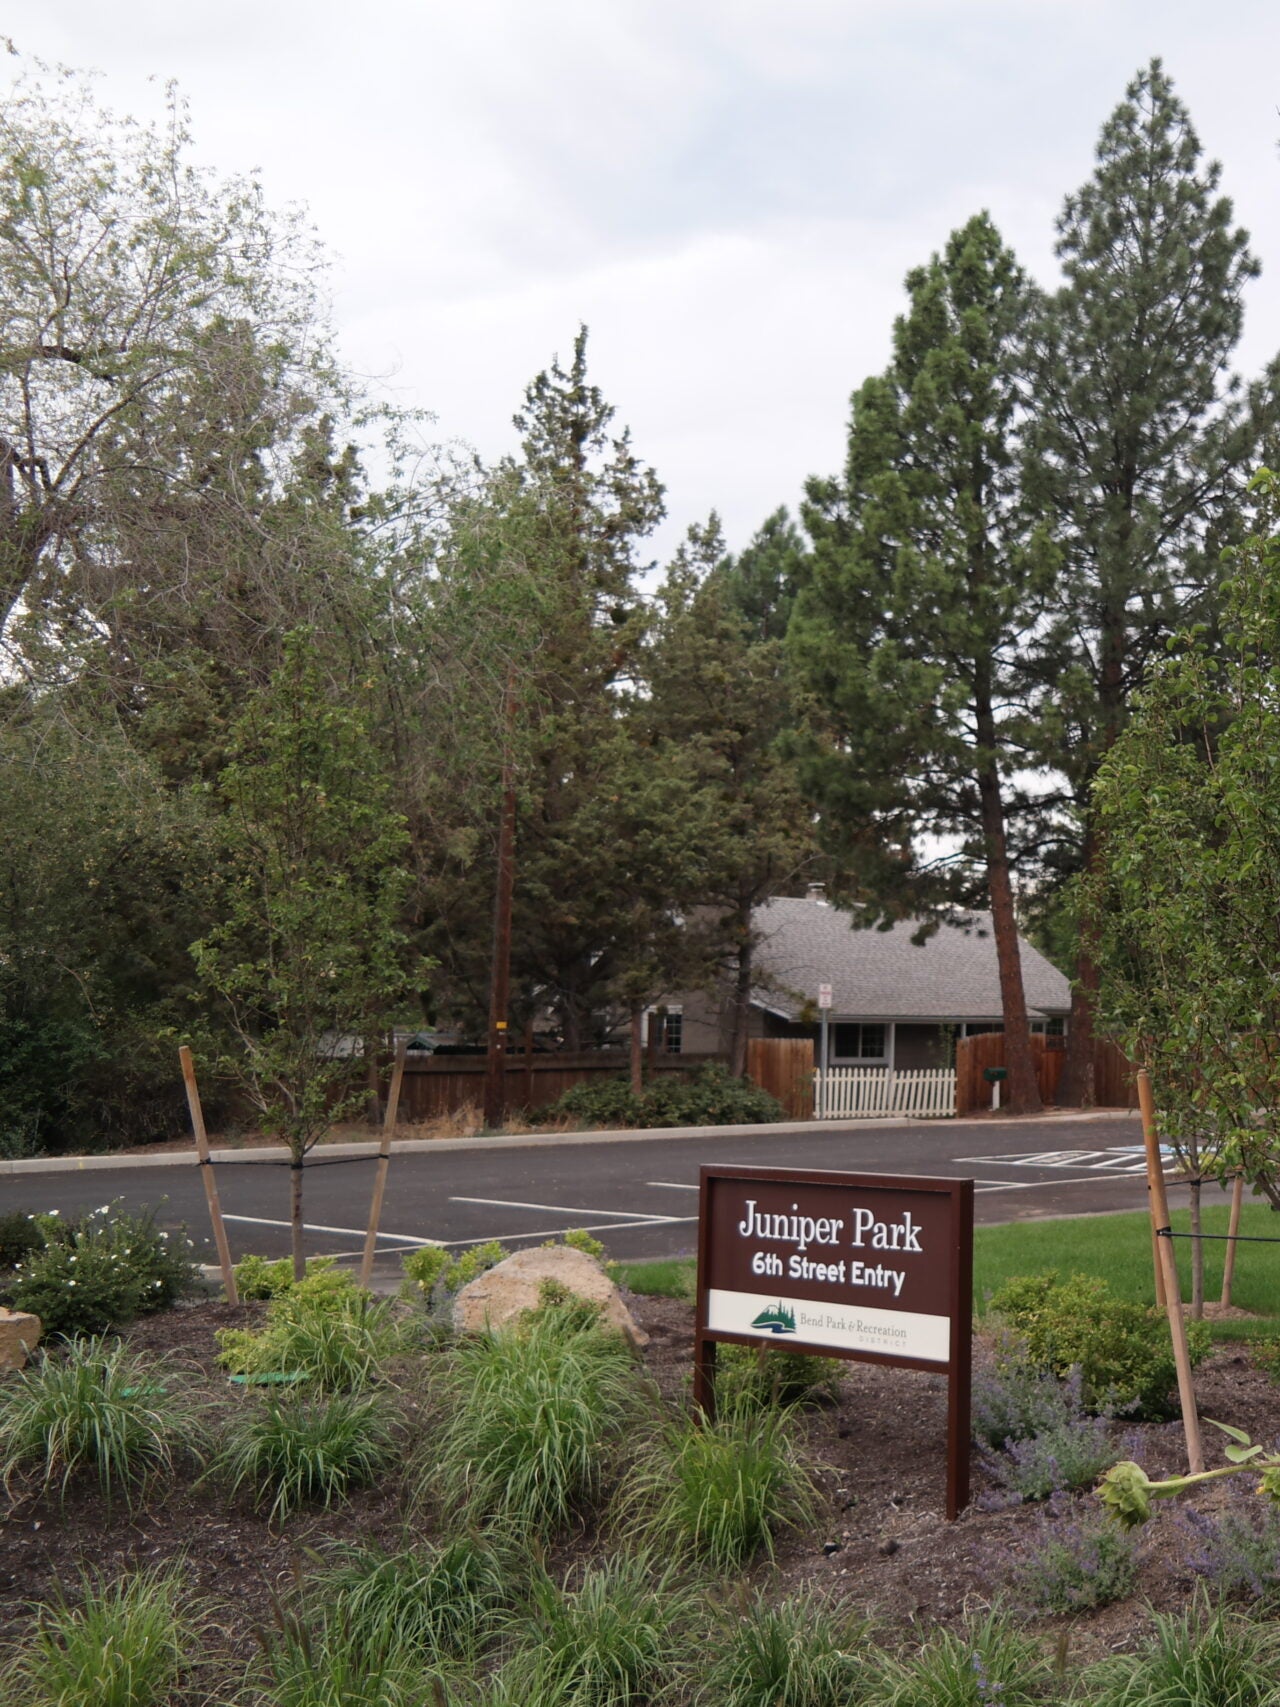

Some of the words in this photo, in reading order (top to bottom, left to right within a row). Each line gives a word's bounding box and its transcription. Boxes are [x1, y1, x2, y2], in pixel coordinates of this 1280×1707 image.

[739, 1200, 844, 1250] Juniper
[852, 1208, 923, 1251] Park
[752, 1252, 783, 1276] 6th
[789, 1256, 846, 1283] Street
[852, 1261, 905, 1296] Entry
[800, 1313, 824, 1329] Bend
[826, 1316, 847, 1331] Park
[856, 1320, 907, 1339] Recreation
